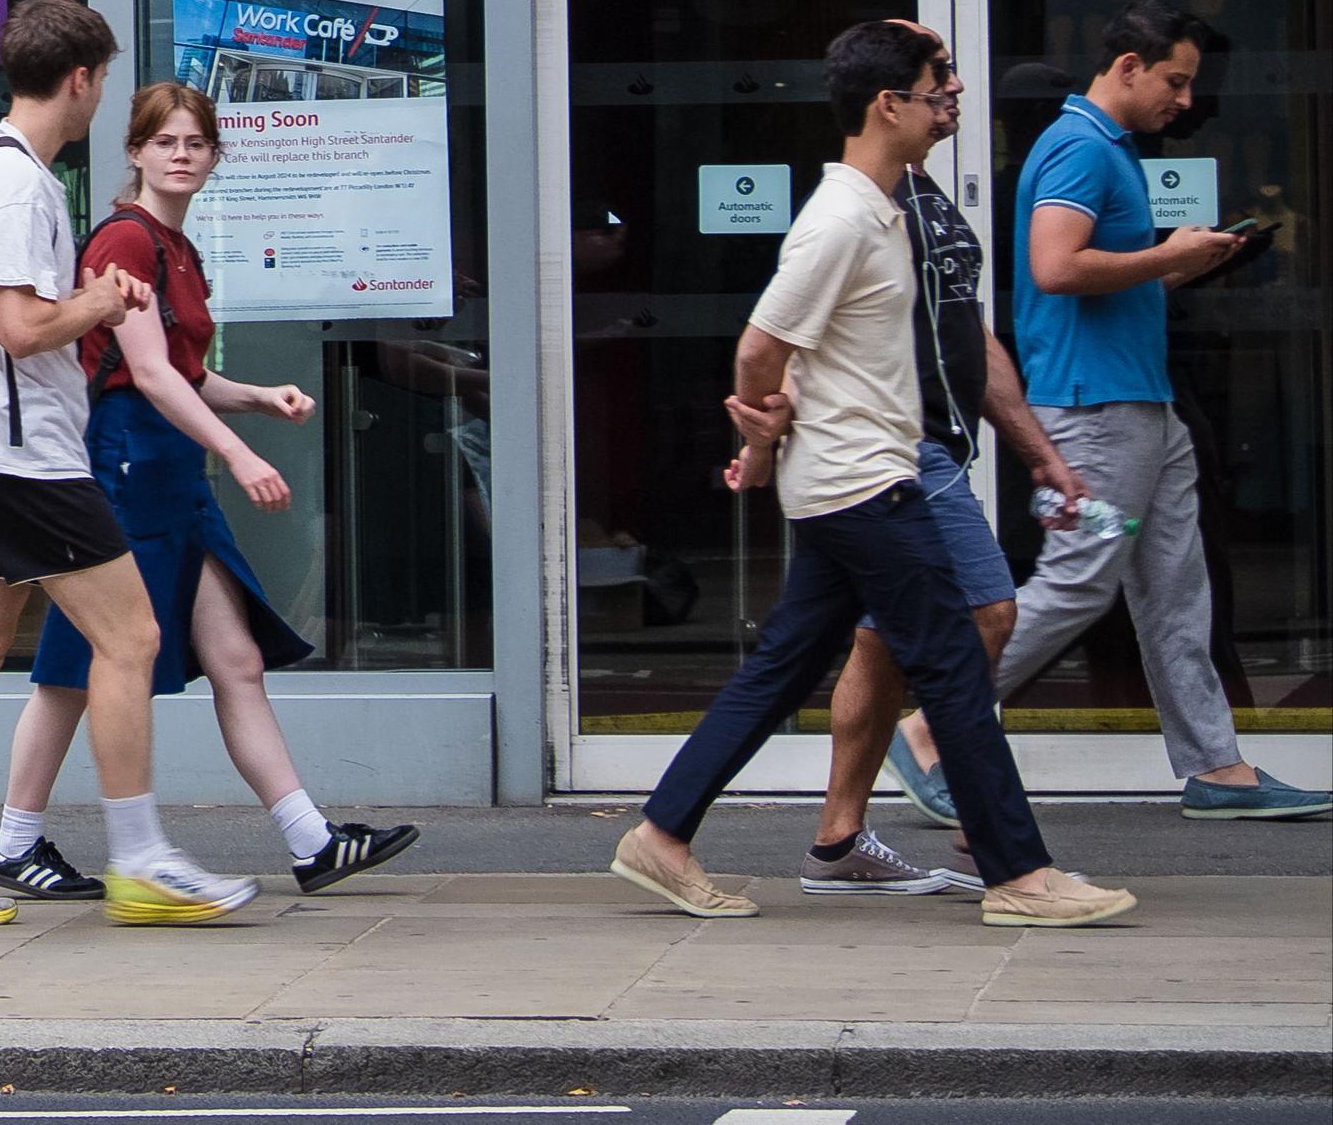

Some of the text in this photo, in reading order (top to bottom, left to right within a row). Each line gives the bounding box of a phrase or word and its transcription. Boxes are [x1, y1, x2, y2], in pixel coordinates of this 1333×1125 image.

[236, 3, 355, 43] Work Café
[234, 28, 307, 50] Santander
[218, 110, 319, 133] ming Soon
[222, 134, 414, 150] ew Kensington High Street Santander
[224, 150, 370, 164] Café will replace this branch
[718, 200, 774, 211] Automatic
[1148, 195, 1199, 205] utomatic
[729, 213, 762, 224] doors
[1155, 207, 1187, 218] doors
[370, 279, 435, 291] Santander
